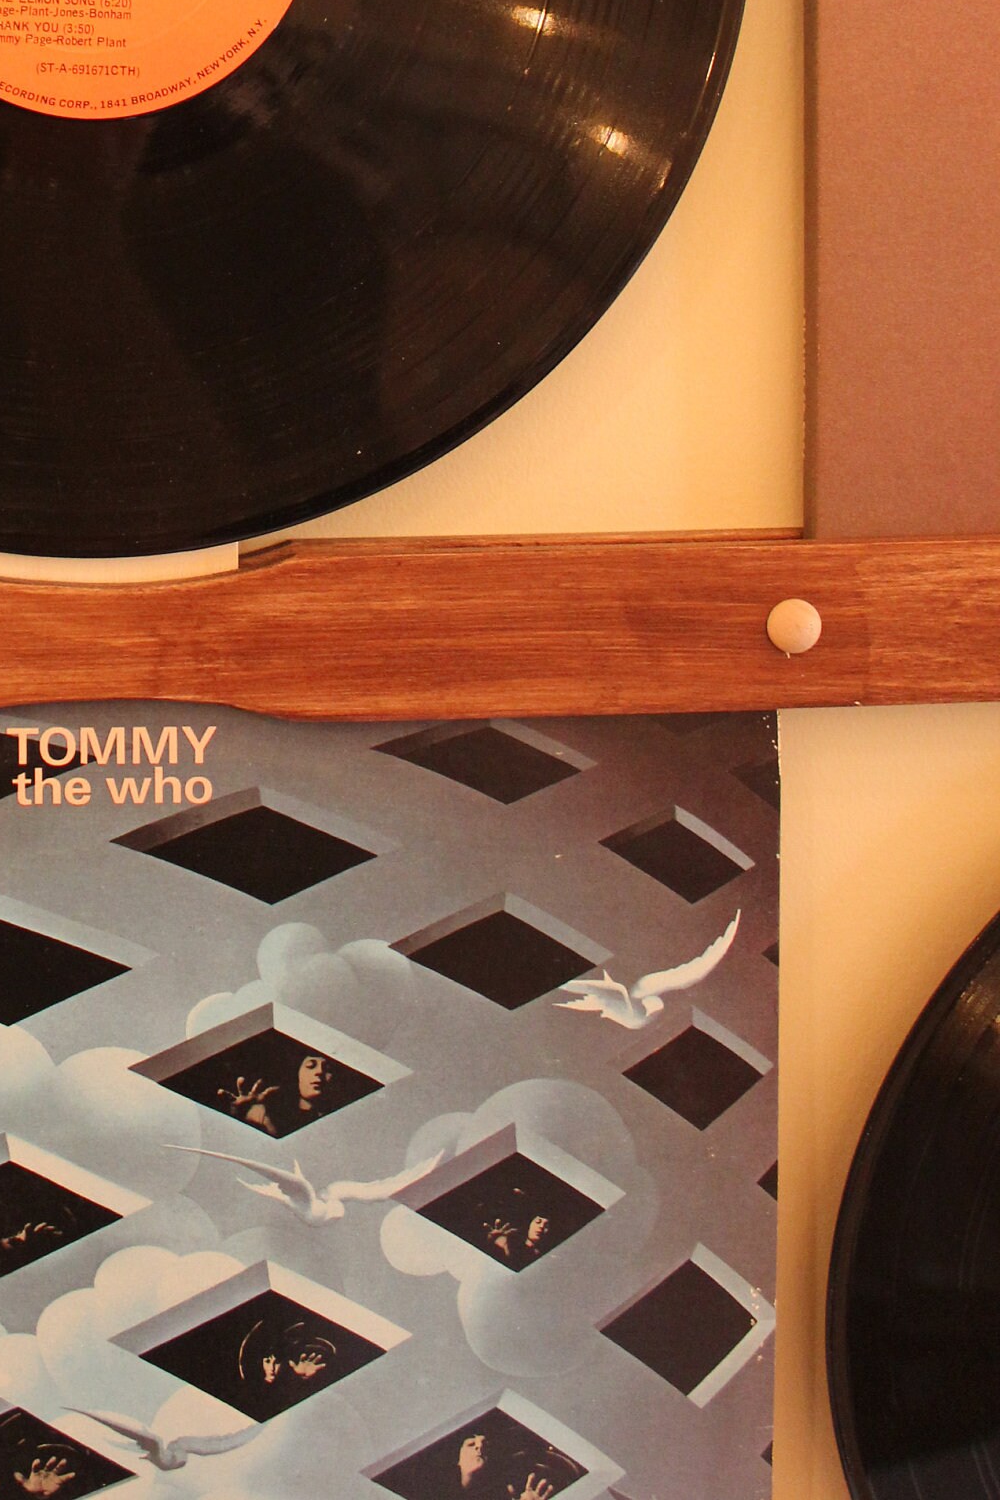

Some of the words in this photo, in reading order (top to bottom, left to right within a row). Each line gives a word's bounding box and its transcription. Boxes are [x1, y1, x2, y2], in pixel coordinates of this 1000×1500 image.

[25, 34, 92, 47] Page-Robert
[97, 36, 127, 48] Plant
[34, 22, 59, 33] YOU
[63, 23, 95, 35] (3:50)
[35, 61, 141, 79] (ST-A-691671CTH)
[100, 99, 127, 109] 1841
[131, 77, 197, 105] BROADWAY,
[196, 60, 220, 80] NEW
[219, 38, 250, 63] YORK,
[247, 18, 268, 38] N.Y.
[5, 725, 217, 767] TOMMY
[11, 767, 92, 806] the
[105, 766, 213, 805] who
